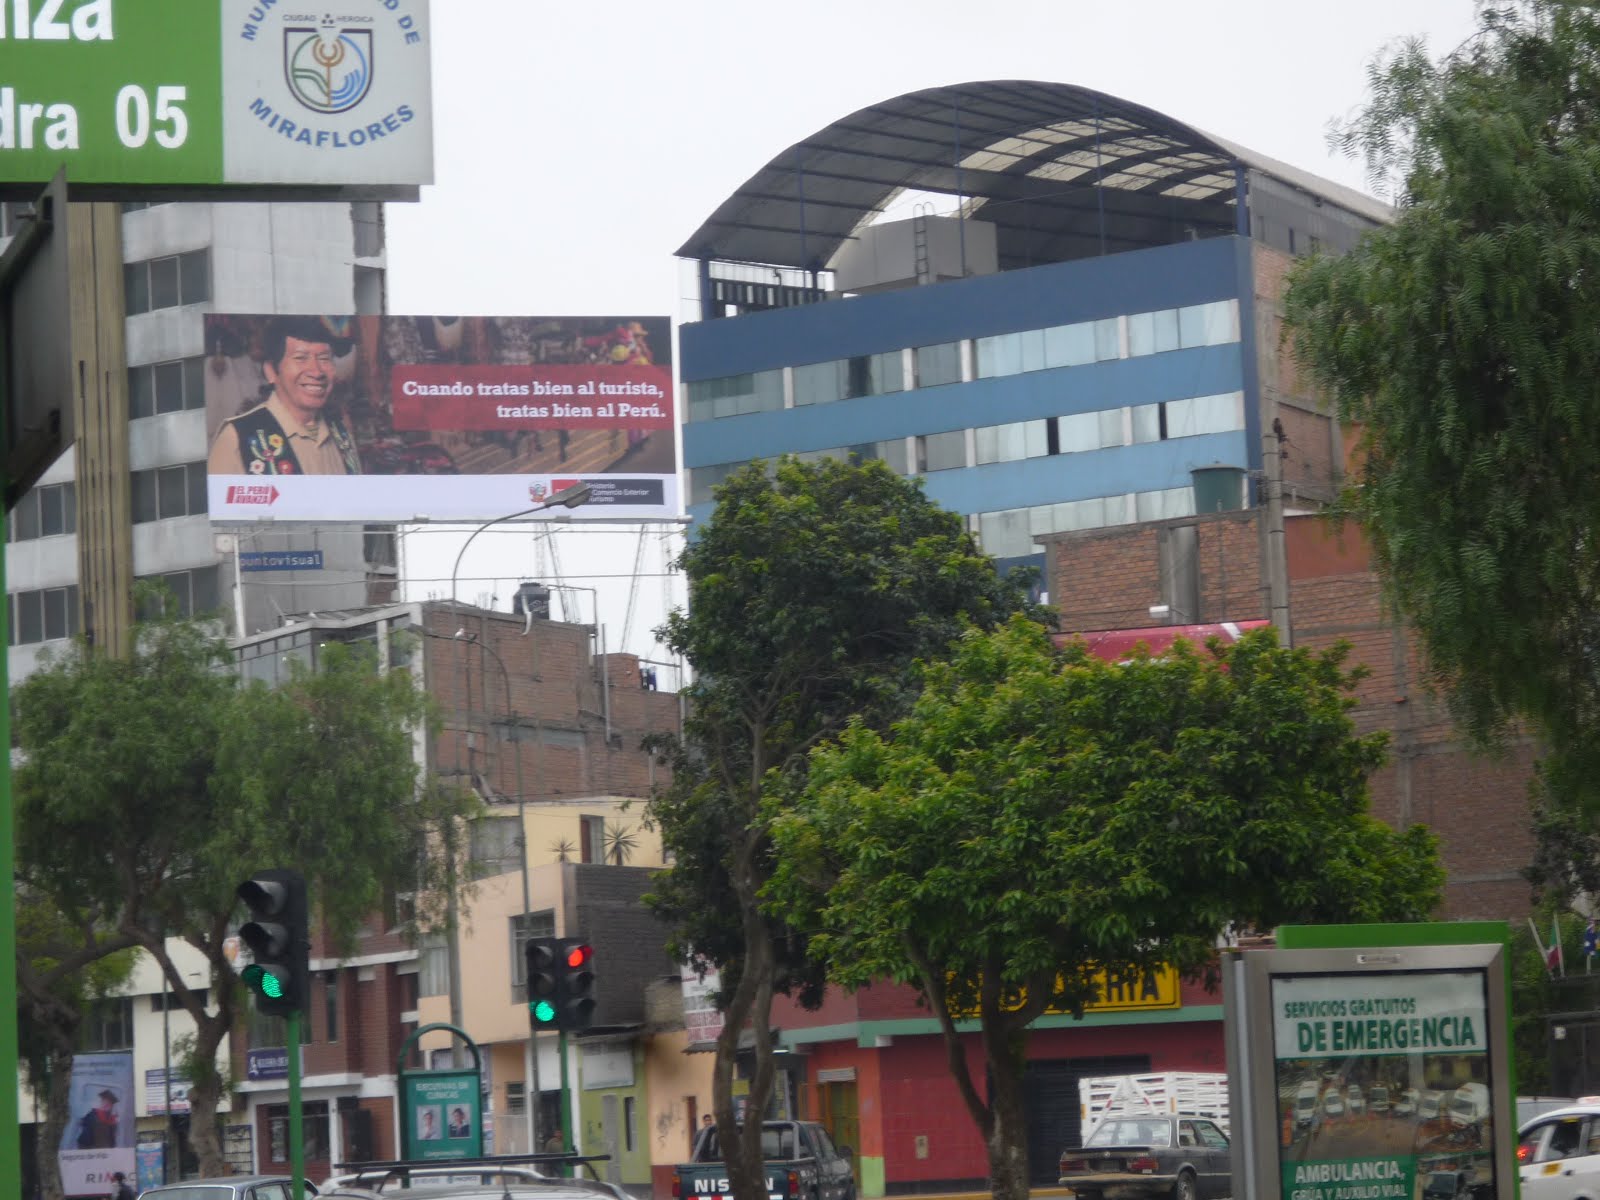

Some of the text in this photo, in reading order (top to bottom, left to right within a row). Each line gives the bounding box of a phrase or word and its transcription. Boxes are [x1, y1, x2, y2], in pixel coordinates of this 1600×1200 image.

[116, 84, 188, 149] 05
[249, 97, 414, 148] MIRAFLORES
[402, 381, 664, 398] Cuando tratas bien al turista,
[496, 403, 666, 418] tratas bien al Perú.
[1284, 997, 1416, 1019] SERVICIOS GRATUITOS
[1297, 1016, 1476, 1052] DE EMERGENCIA
[1295, 1160, 1406, 1184] AMBULANCIA,
[694, 1177, 775, 1194] NISN
[1334, 1185, 1380, 1199] AUXILIO
[1381, 1184, 1408, 1198] VIAL
